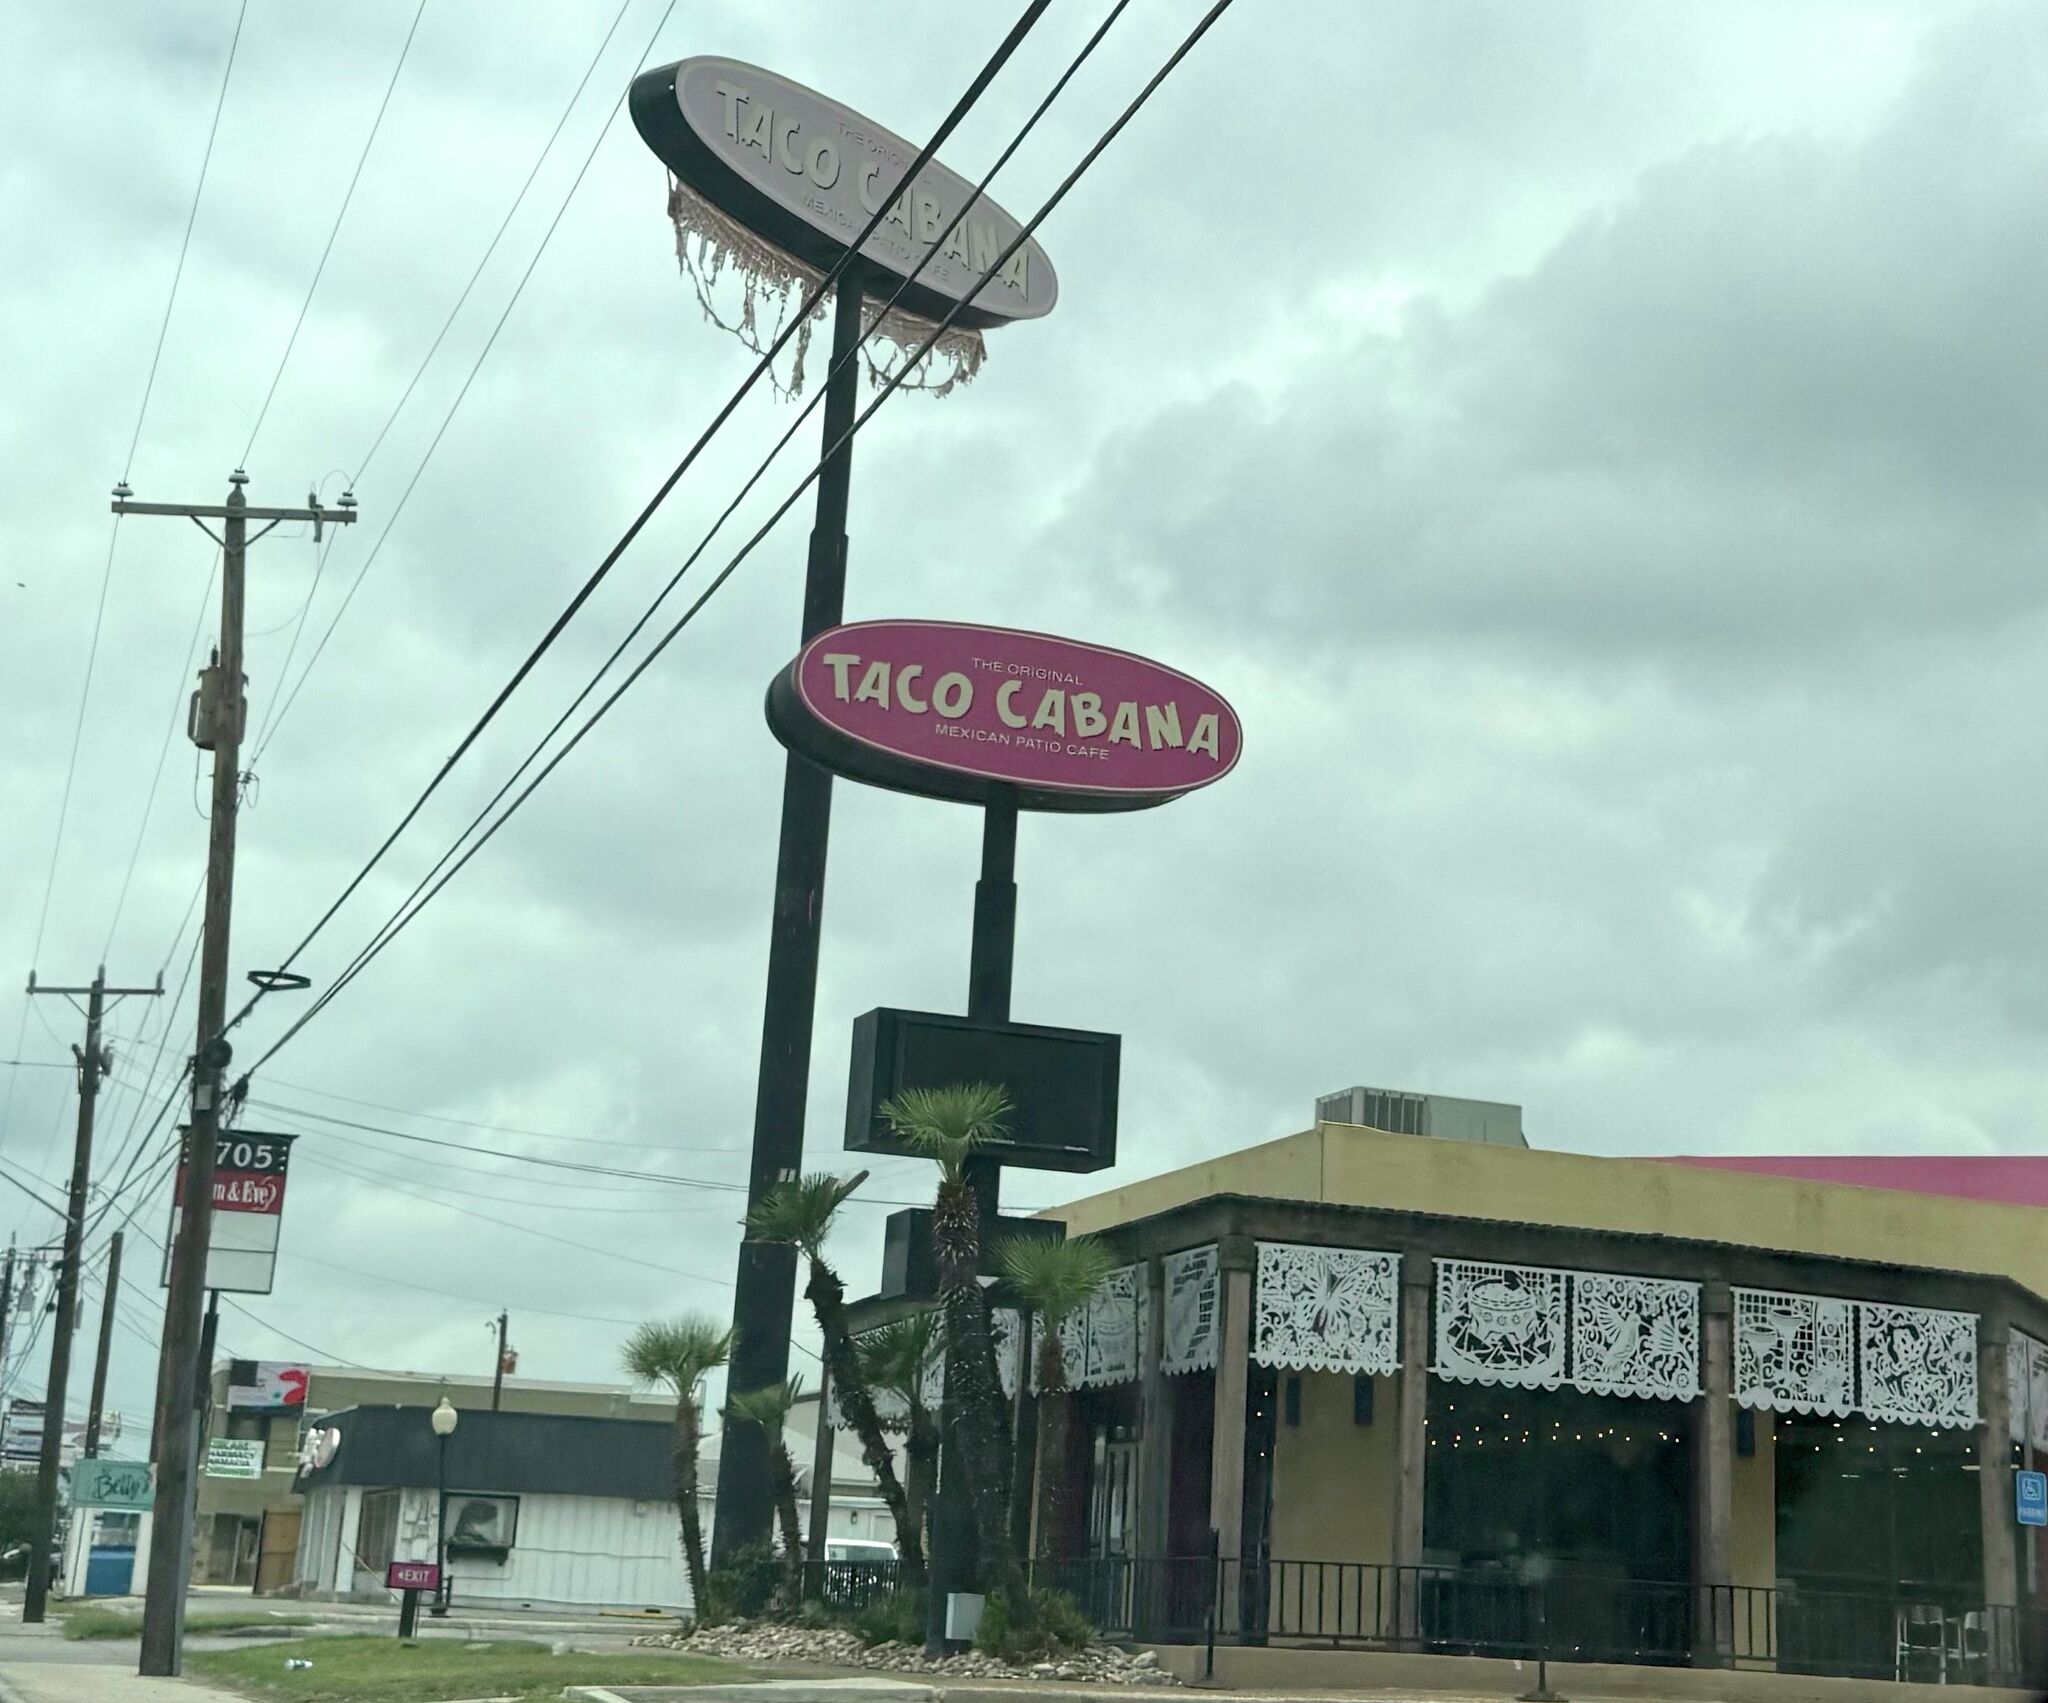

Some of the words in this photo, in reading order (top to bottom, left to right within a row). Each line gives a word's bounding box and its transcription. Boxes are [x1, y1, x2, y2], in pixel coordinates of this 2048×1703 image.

[714, 79, 842, 190] TACO
[858, 160, 1030, 302] CABANA
[972, 656, 1004, 674] THE
[1007, 662, 1084, 687] ORIGINAL
[823, 653, 974, 719] TACO
[996, 679, 1219, 763] CABANA
[935, 722, 1011, 745] MEXICAN
[1015, 735, 1061, 754] PATIO
[1066, 743, 1111, 761] CAFE
[227, 1181, 240, 1202] &
[404, 1569, 430, 1583] EXIT
